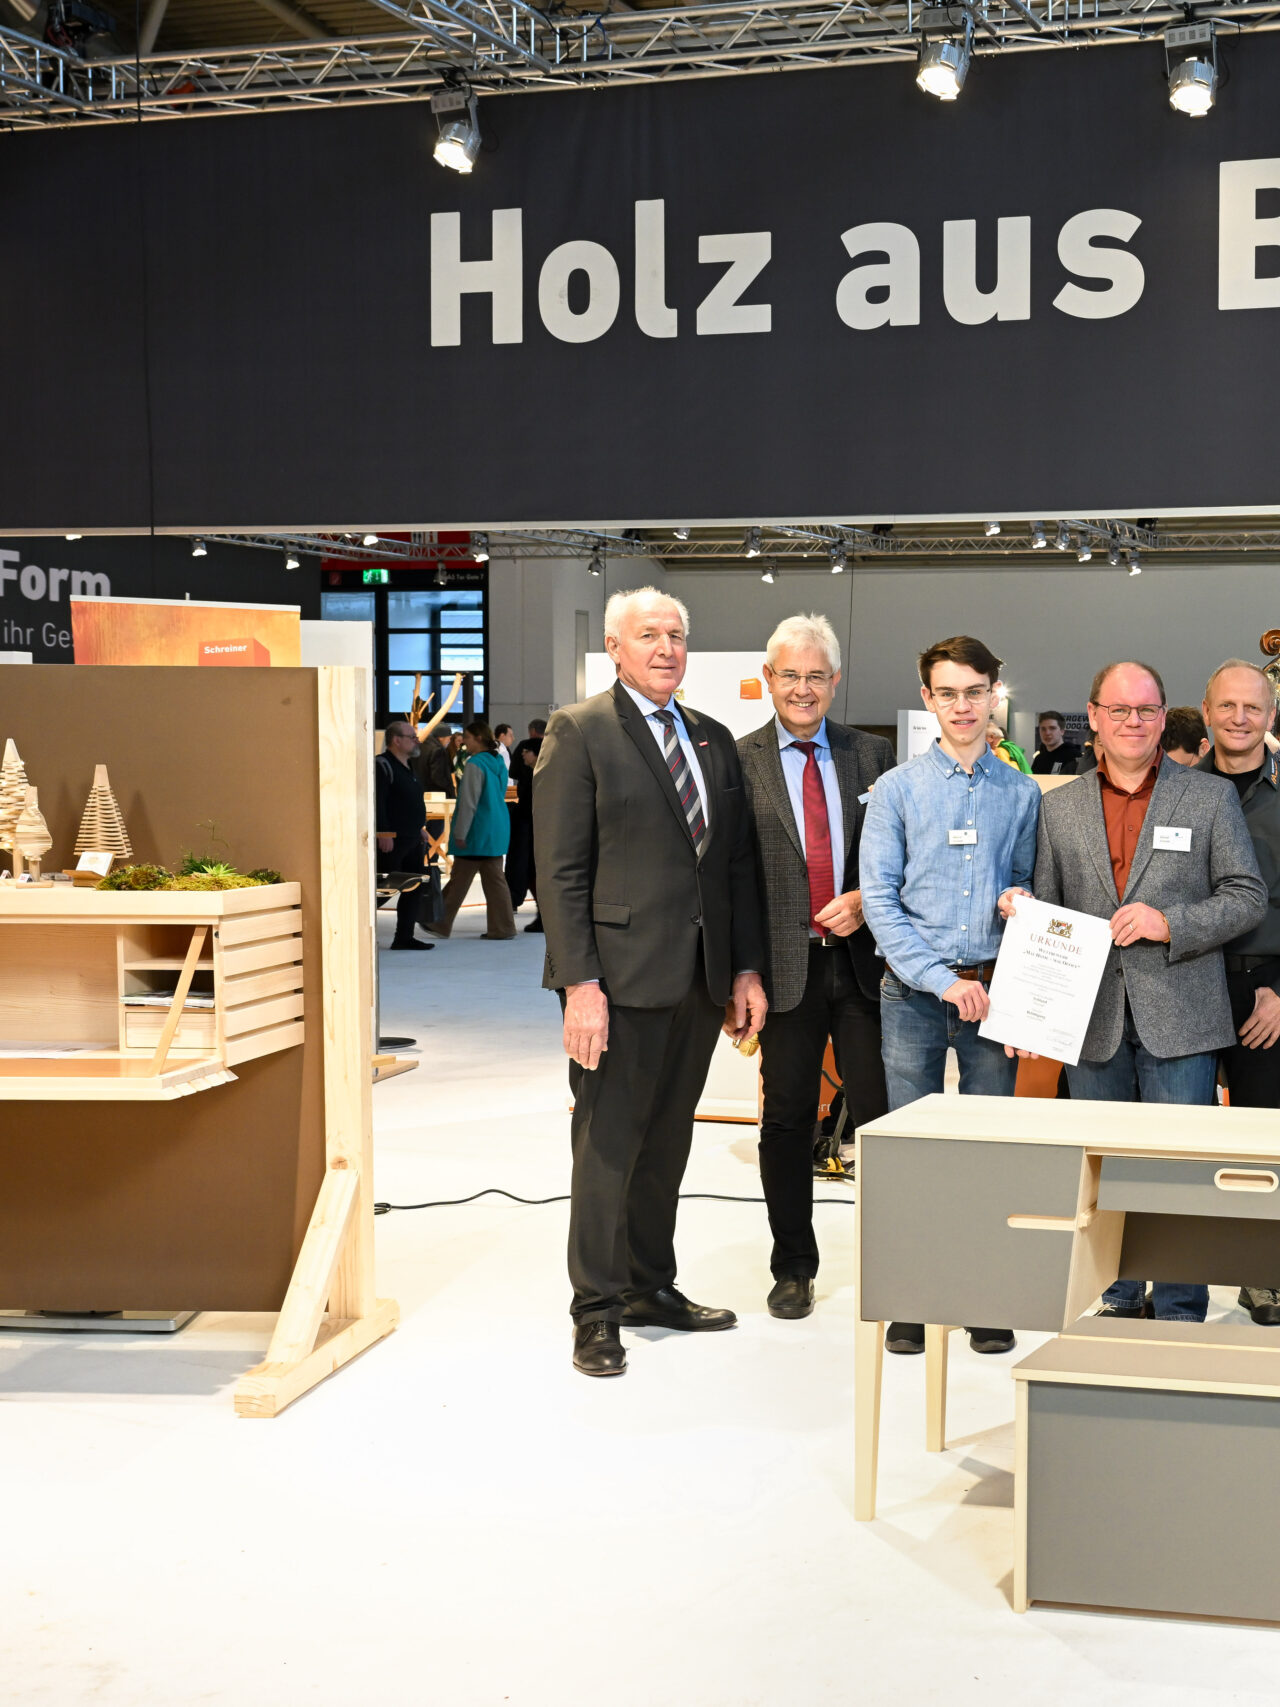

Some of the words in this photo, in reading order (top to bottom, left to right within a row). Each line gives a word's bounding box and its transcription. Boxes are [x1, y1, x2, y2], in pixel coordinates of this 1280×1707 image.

[430, 198, 772, 347] Holz
[836, 208, 1145, 331] aus
[0, 549, 111, 601] Form
[4, 619, 34, 646] ihr
[41, 622, 75, 648] Ge
[203, 643, 248, 655] Schreiner
[1030, 932, 1082, 955] URKUNDE
